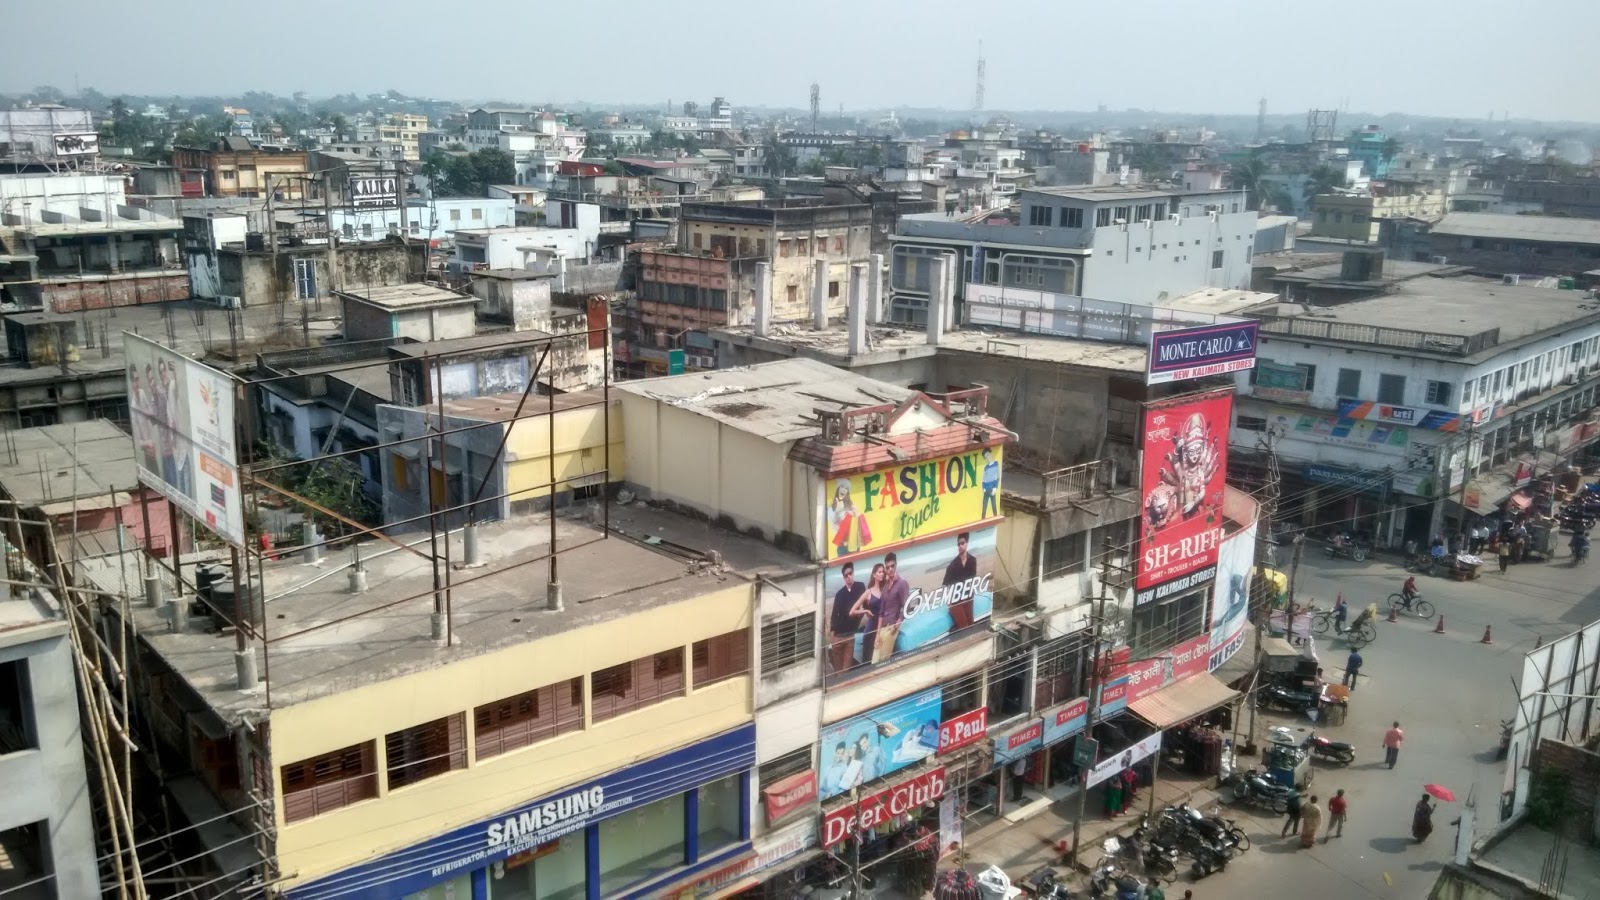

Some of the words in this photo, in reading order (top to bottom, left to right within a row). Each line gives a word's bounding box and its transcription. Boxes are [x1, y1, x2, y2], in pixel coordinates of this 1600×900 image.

[351, 178, 397, 196] KALIKA
[1159, 341, 1197, 361] MONTE
[1199, 336, 1232, 356] CARLO
[1173, 370, 1189, 380] NEW
[1192, 364, 1225, 377] KALIMATA
[1227, 359, 1252, 371] STORES
[1392, 410, 1412, 420] uti
[863, 453, 978, 513] FASHION
[899, 494, 940, 539] touch
[1144, 528, 1219, 572] SH-RIFF
[903, 572, 992, 620] OXEMBERG
[1136, 588, 1155, 606] NEW
[1155, 576, 1190, 599] KALIMATA
[1190, 566, 1216, 587] STORES
[1209, 650, 1222, 671] HI
[1224, 632, 1244, 659] FAS
[1059, 704, 1084, 722] TIMEX
[1103, 687, 1124, 702] TIMEX
[940, 711, 986, 748] S.Paul
[1011, 727, 1037, 744] TIMEX
[487, 786, 605, 846] SAMSUNG
[825, 804, 887, 847] Deer
[890, 776, 945, 815] Club
[507, 834, 547, 857] EXCLUSIVE
[547, 820, 586, 841] SHOWROOM
